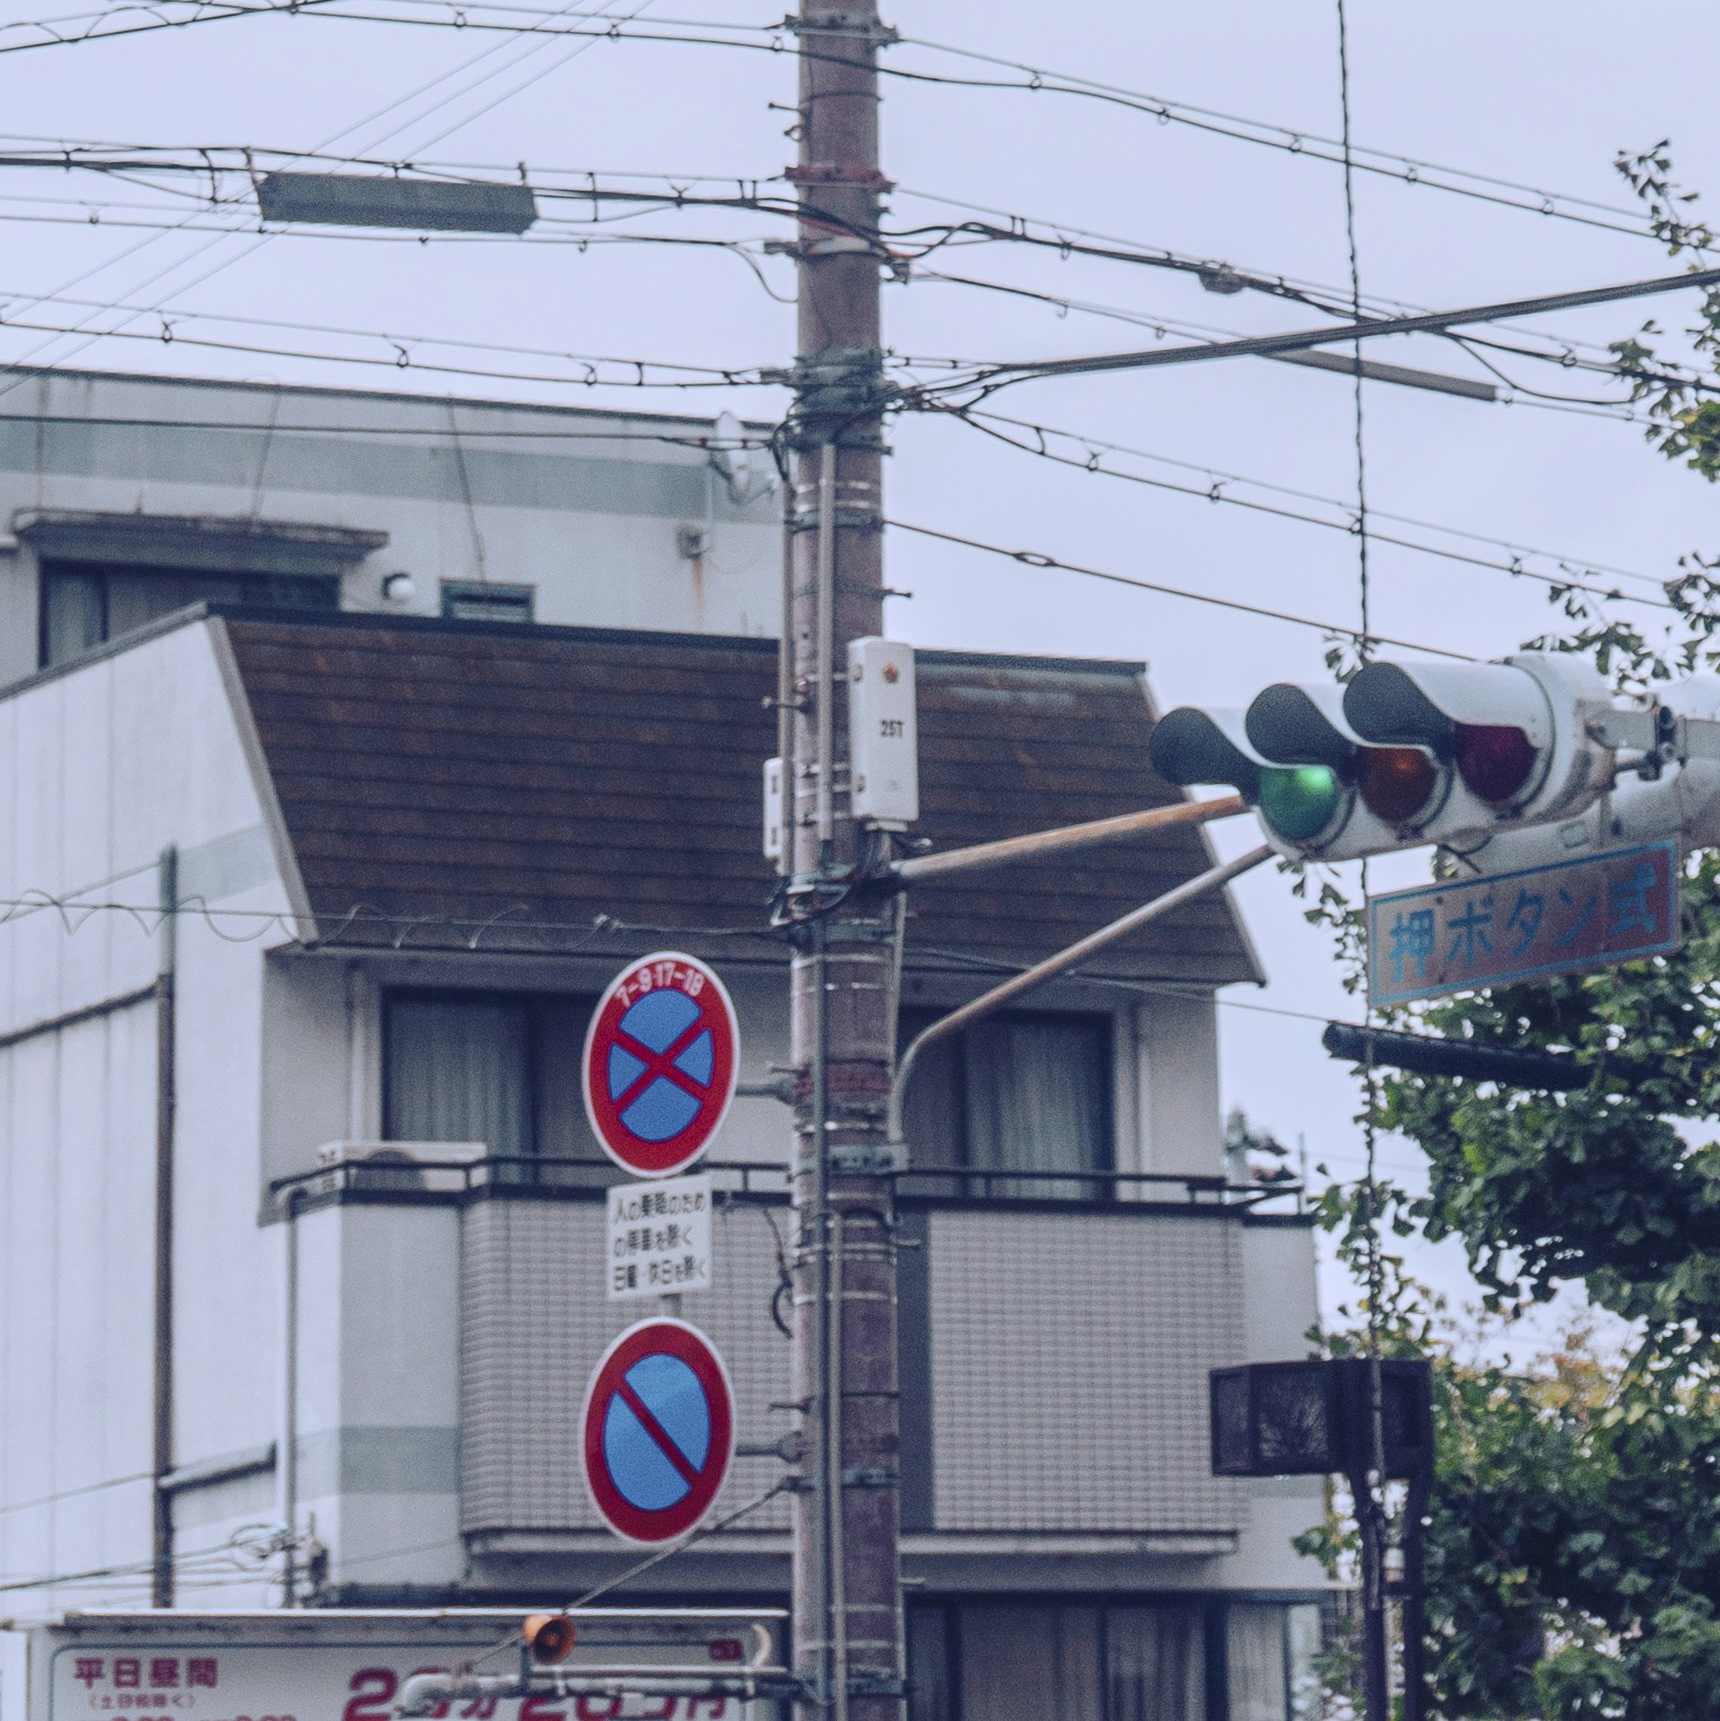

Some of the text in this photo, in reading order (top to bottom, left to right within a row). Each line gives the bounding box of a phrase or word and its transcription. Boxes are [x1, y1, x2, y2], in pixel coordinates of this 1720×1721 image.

[1389, 862, 1656, 982] 押ボタン式
[74, 1657, 217, 1689] 平日昼間
